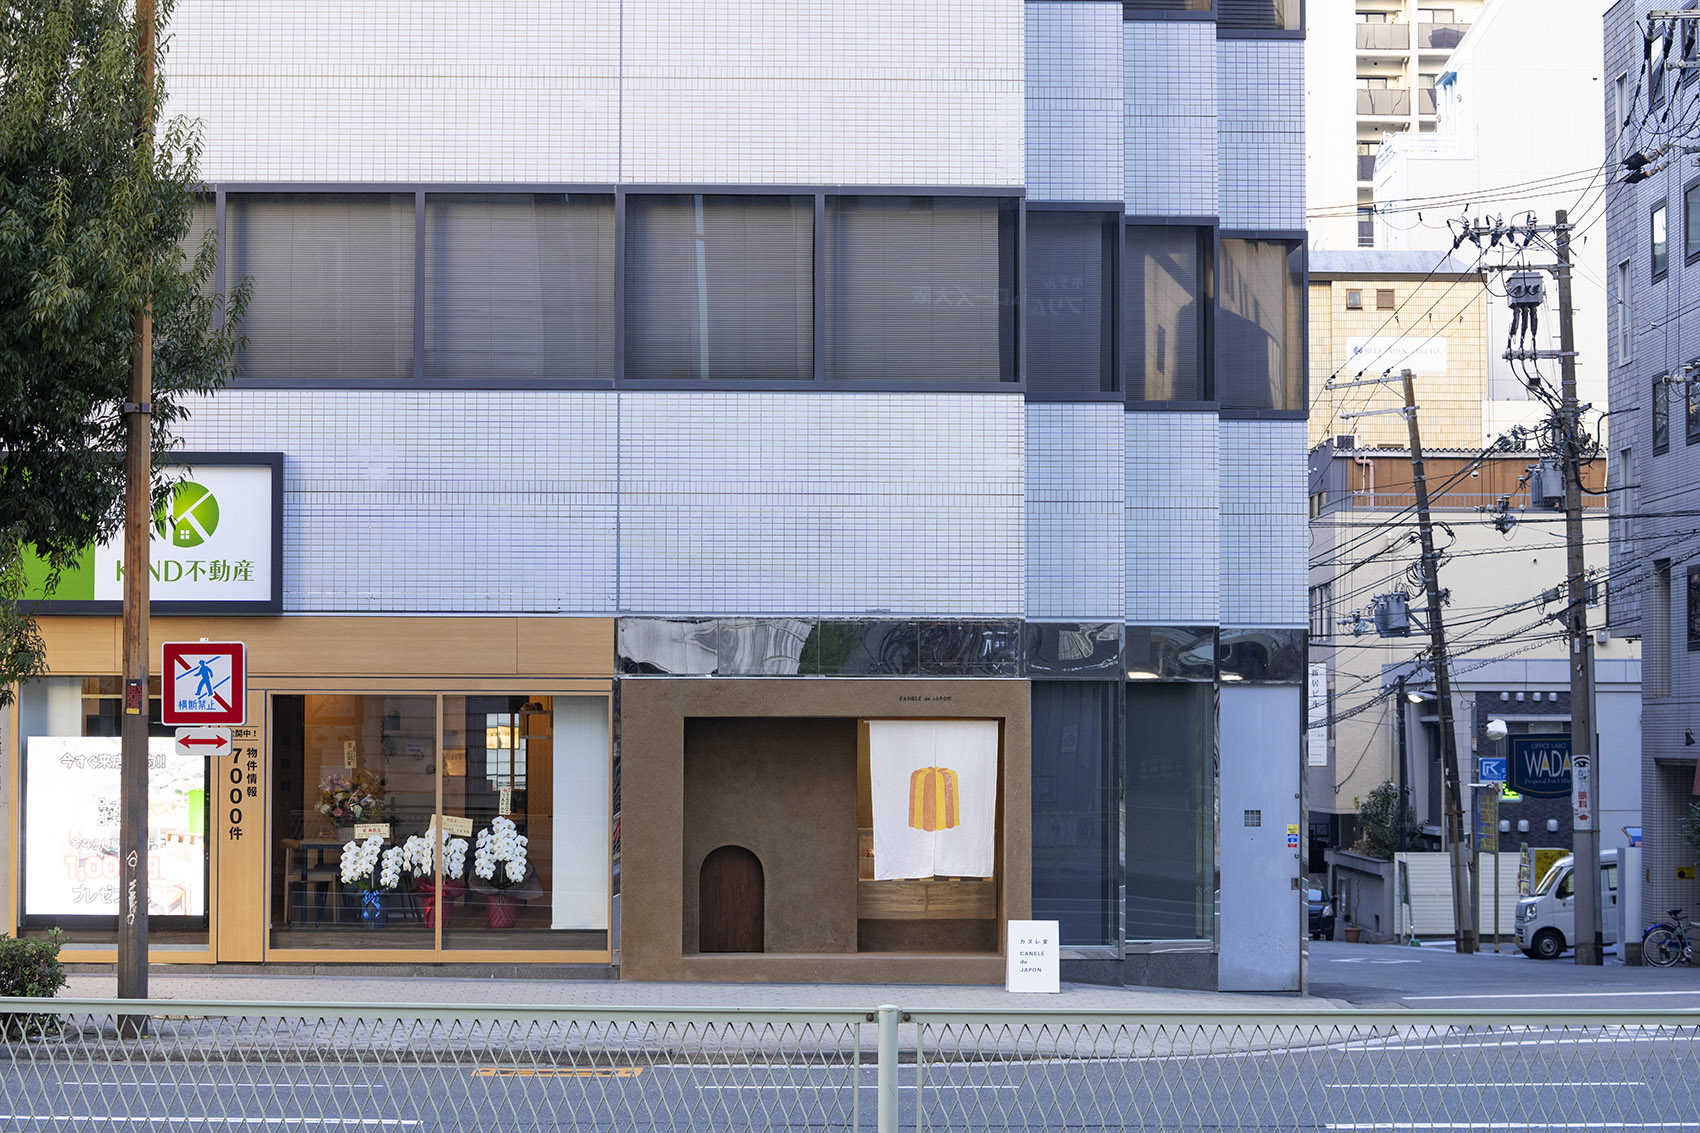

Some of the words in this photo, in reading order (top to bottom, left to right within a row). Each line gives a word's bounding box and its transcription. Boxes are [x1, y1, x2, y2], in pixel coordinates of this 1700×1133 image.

[116, 559, 255, 582] KND不動産
[178, 699, 217, 711] 横断禁止
[246, 747, 258, 798] 物件情報
[1524, 750, 1571, 777] WADA
[229, 747, 243, 841] 7000件
